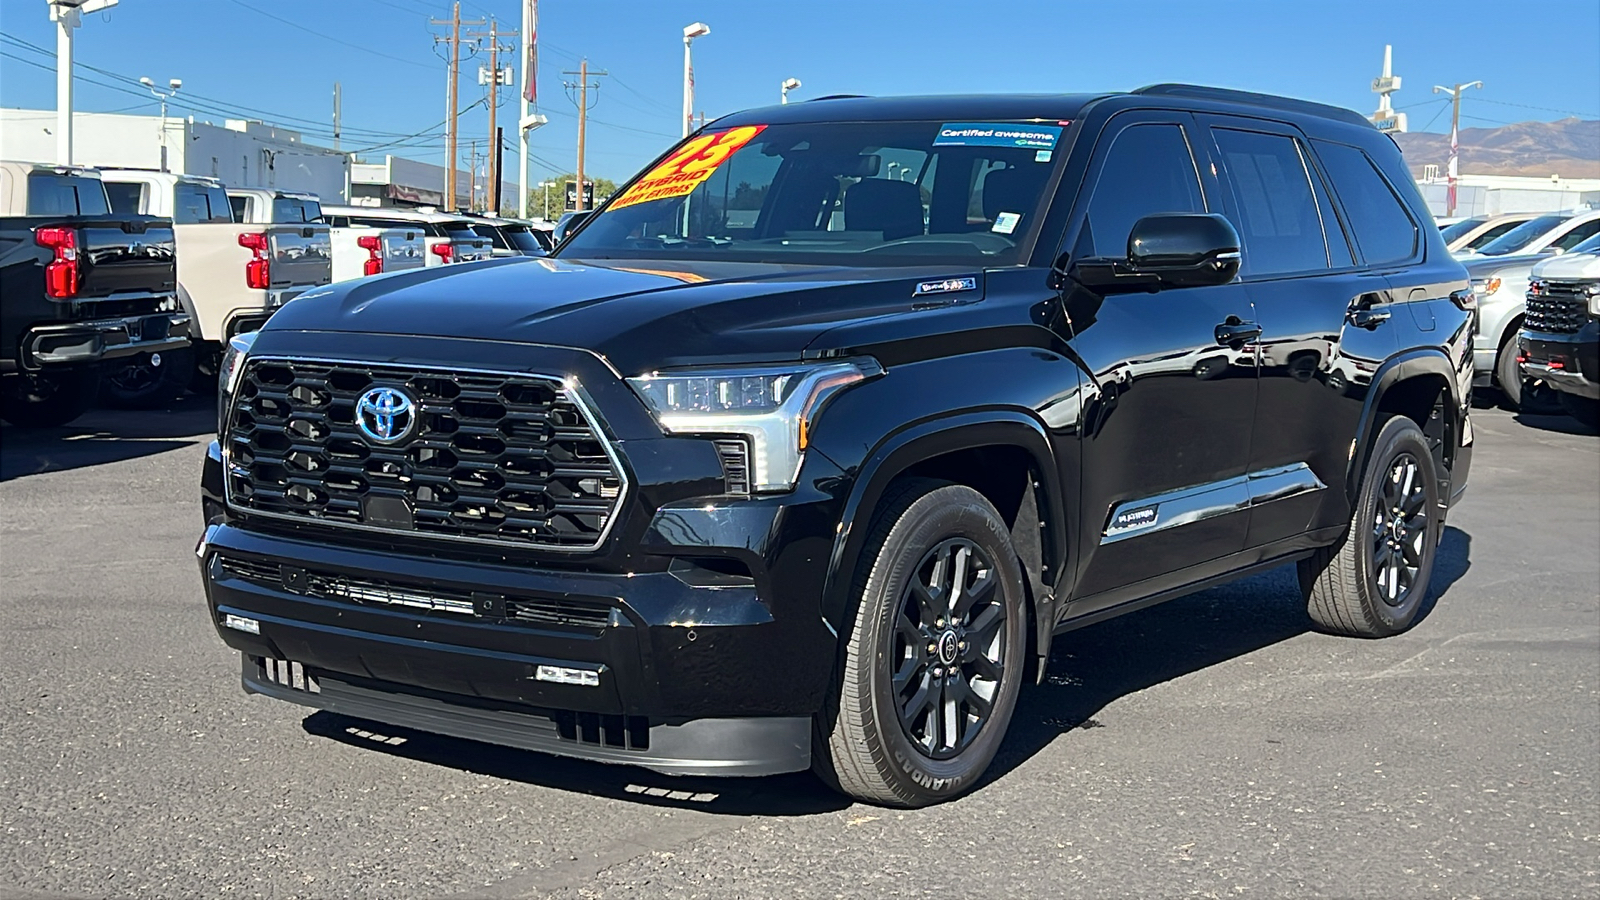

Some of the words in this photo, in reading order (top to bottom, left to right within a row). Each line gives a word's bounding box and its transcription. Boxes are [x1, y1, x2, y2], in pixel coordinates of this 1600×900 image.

[941, 129, 993, 137] Certified
[642, 126, 758, 180] 23
[630, 169, 708, 194] HYBRID
[644, 183, 694, 199] EXTRAS
